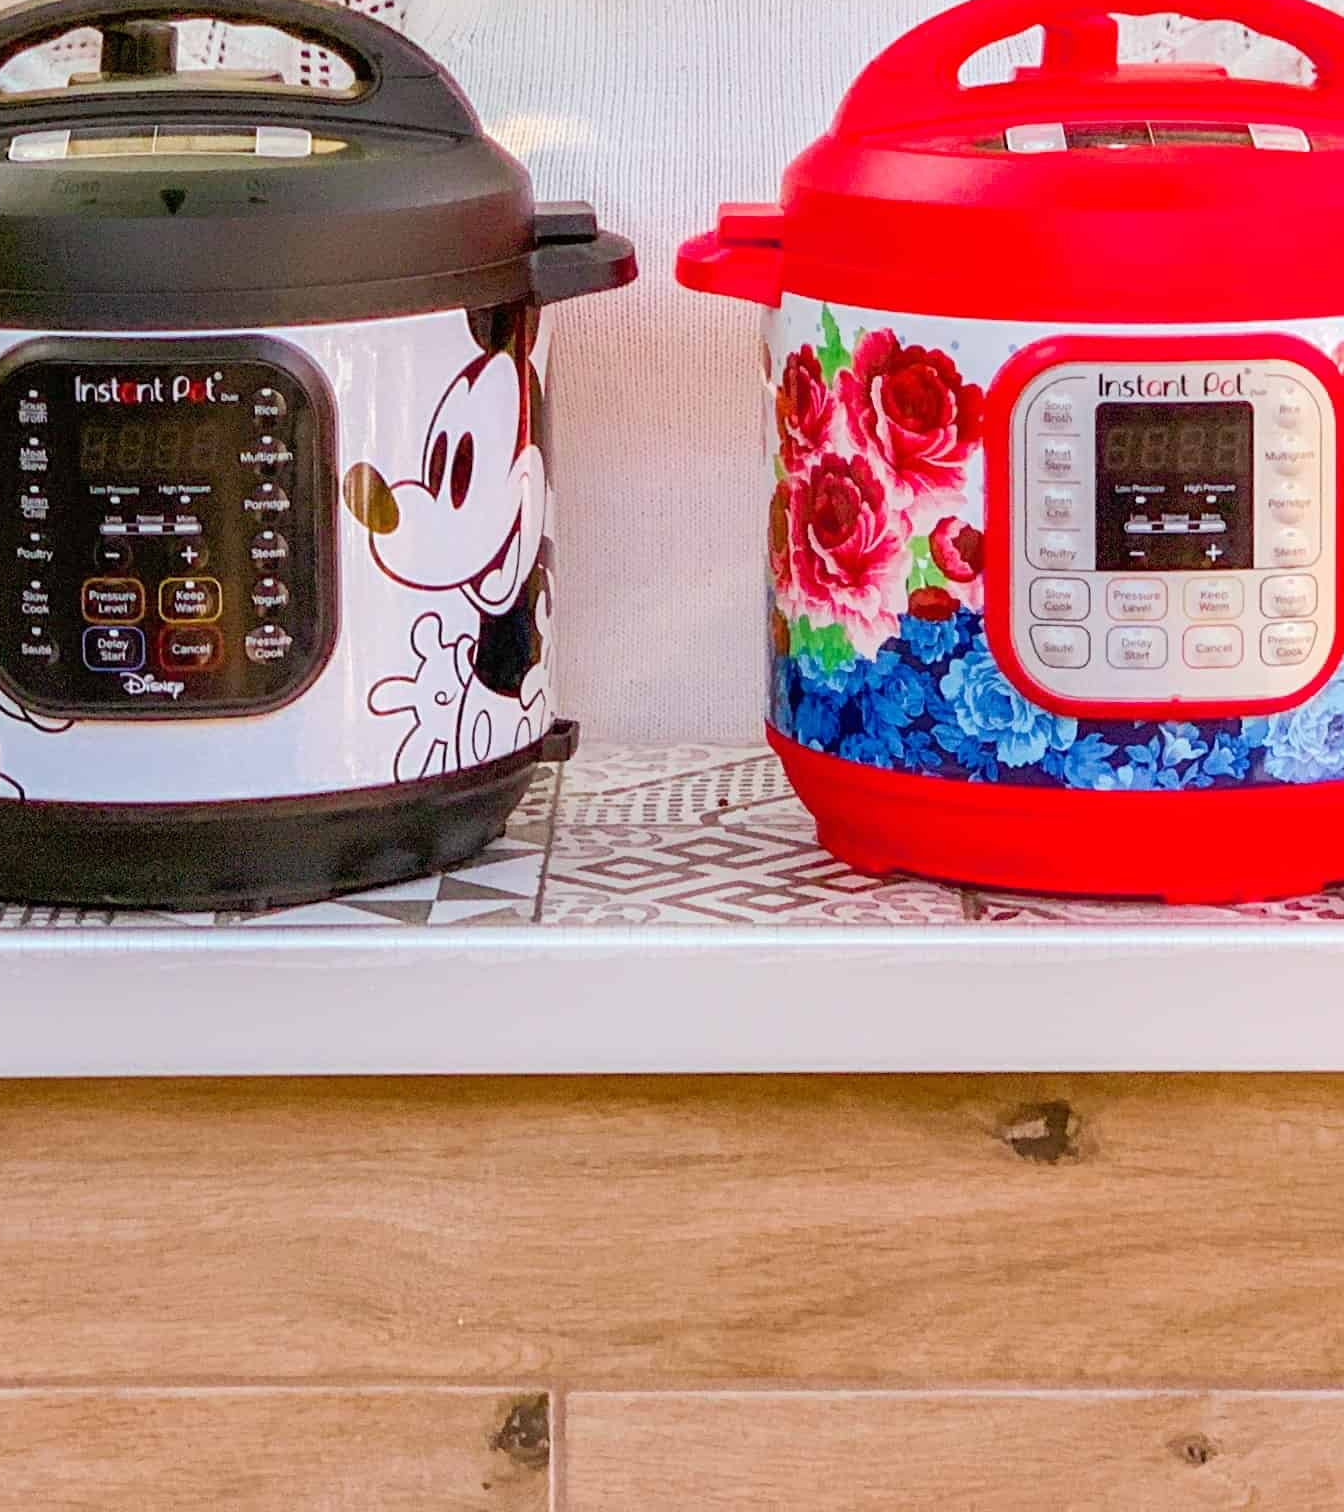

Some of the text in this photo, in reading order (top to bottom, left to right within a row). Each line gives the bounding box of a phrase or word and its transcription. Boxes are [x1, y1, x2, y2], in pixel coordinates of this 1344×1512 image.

[75, 376, 163, 403] Instant
[1098, 372, 1187, 397] Instant
[1203, 372, 1244, 397] Pot
[254, 405, 278, 416] Rice
[240, 451, 293, 464] Multigrain
[18, 548, 53, 562] Poultry
[251, 548, 285, 559] Steam
[23, 590, 49, 603] Slow
[88, 591, 136, 603] Pressure
[175, 591, 205, 604] Keep
[253, 592, 287, 606] Yogurt
[22, 603, 49, 615] Cook
[98, 602, 128, 614] Level
[174, 602, 207, 615] Warm
[98, 639, 129, 652] Delay
[246, 636, 293, 647] Pressure
[101, 650, 126, 661] Start
[172, 644, 210, 656] Cancel
[256, 647, 284, 658] Cook
[120, 672, 184, 700] Disney
